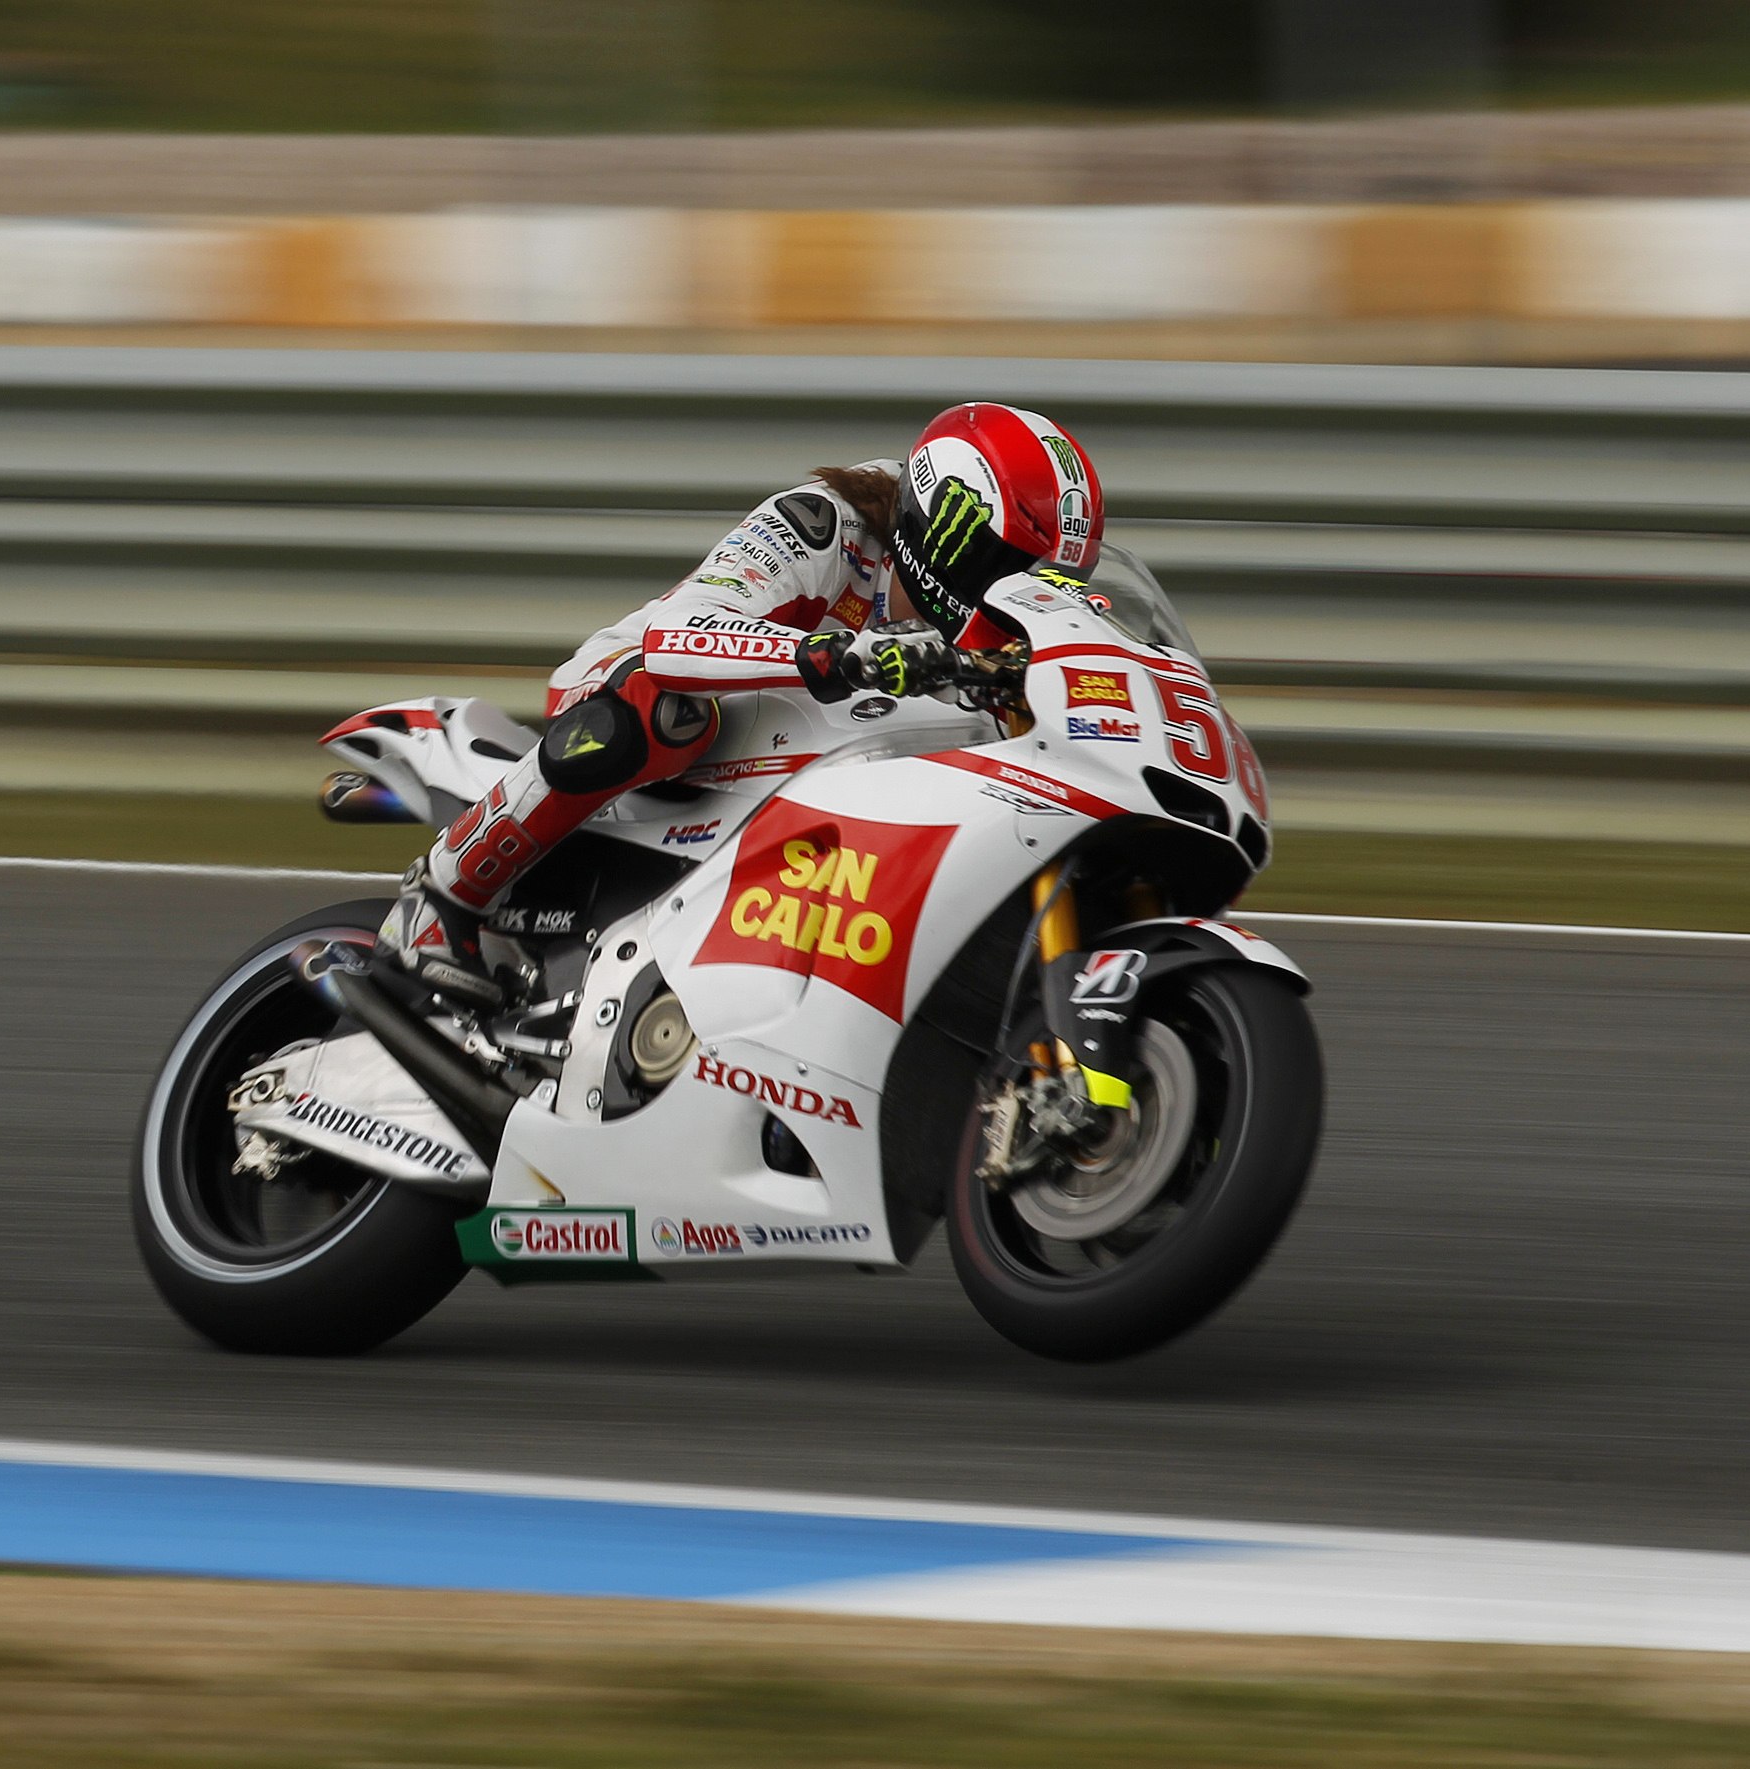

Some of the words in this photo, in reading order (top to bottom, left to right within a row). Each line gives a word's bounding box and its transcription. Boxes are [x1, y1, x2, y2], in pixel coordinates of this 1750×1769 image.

[1063, 516, 1089, 537] agv
[740, 542, 782, 577] SAGTUBI
[1060, 540, 1083, 563] 58
[893, 529, 974, 620] MONSTER
[657, 631, 796, 661] HONDA
[1069, 686, 1129, 702] CARLO
[1078, 675, 1117, 688] SAN
[1066, 717, 1140, 736] BigMat
[446, 777, 540, 895] 58
[661, 818, 722, 845] HRC
[778, 839, 879, 904] SAN
[534, 910, 577, 929] NGK
[693, 1054, 863, 1130] HONDA
[286, 1092, 474, 1182] BRIDGESTONE
[525, 1217, 623, 1255] Castrol
[681, 1217, 743, 1255] Agos
[769, 1221, 872, 1244] DUCATO
